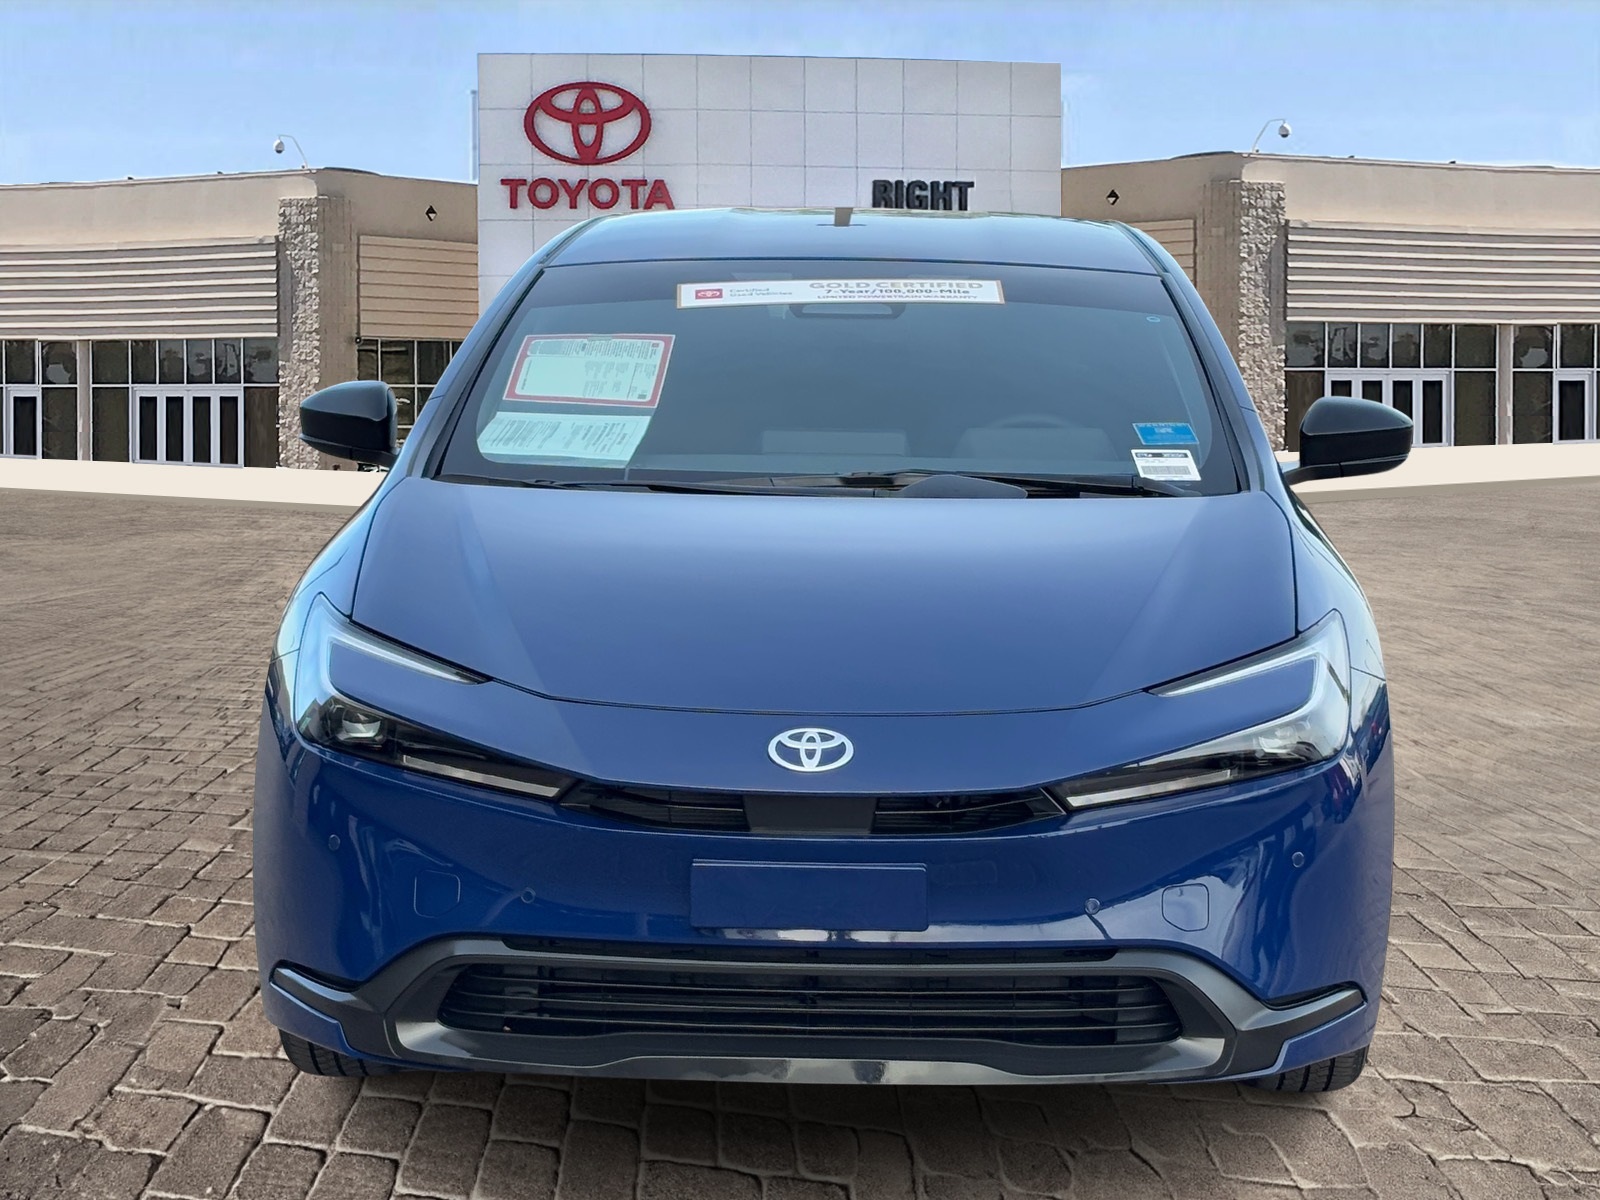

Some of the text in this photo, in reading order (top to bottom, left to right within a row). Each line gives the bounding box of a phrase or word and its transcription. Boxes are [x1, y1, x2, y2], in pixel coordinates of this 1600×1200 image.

[501, 178, 675, 210] TOYOTA
[872, 179, 975, 211] RIGHT
[875, 281, 983, 289] CERTIFIED
